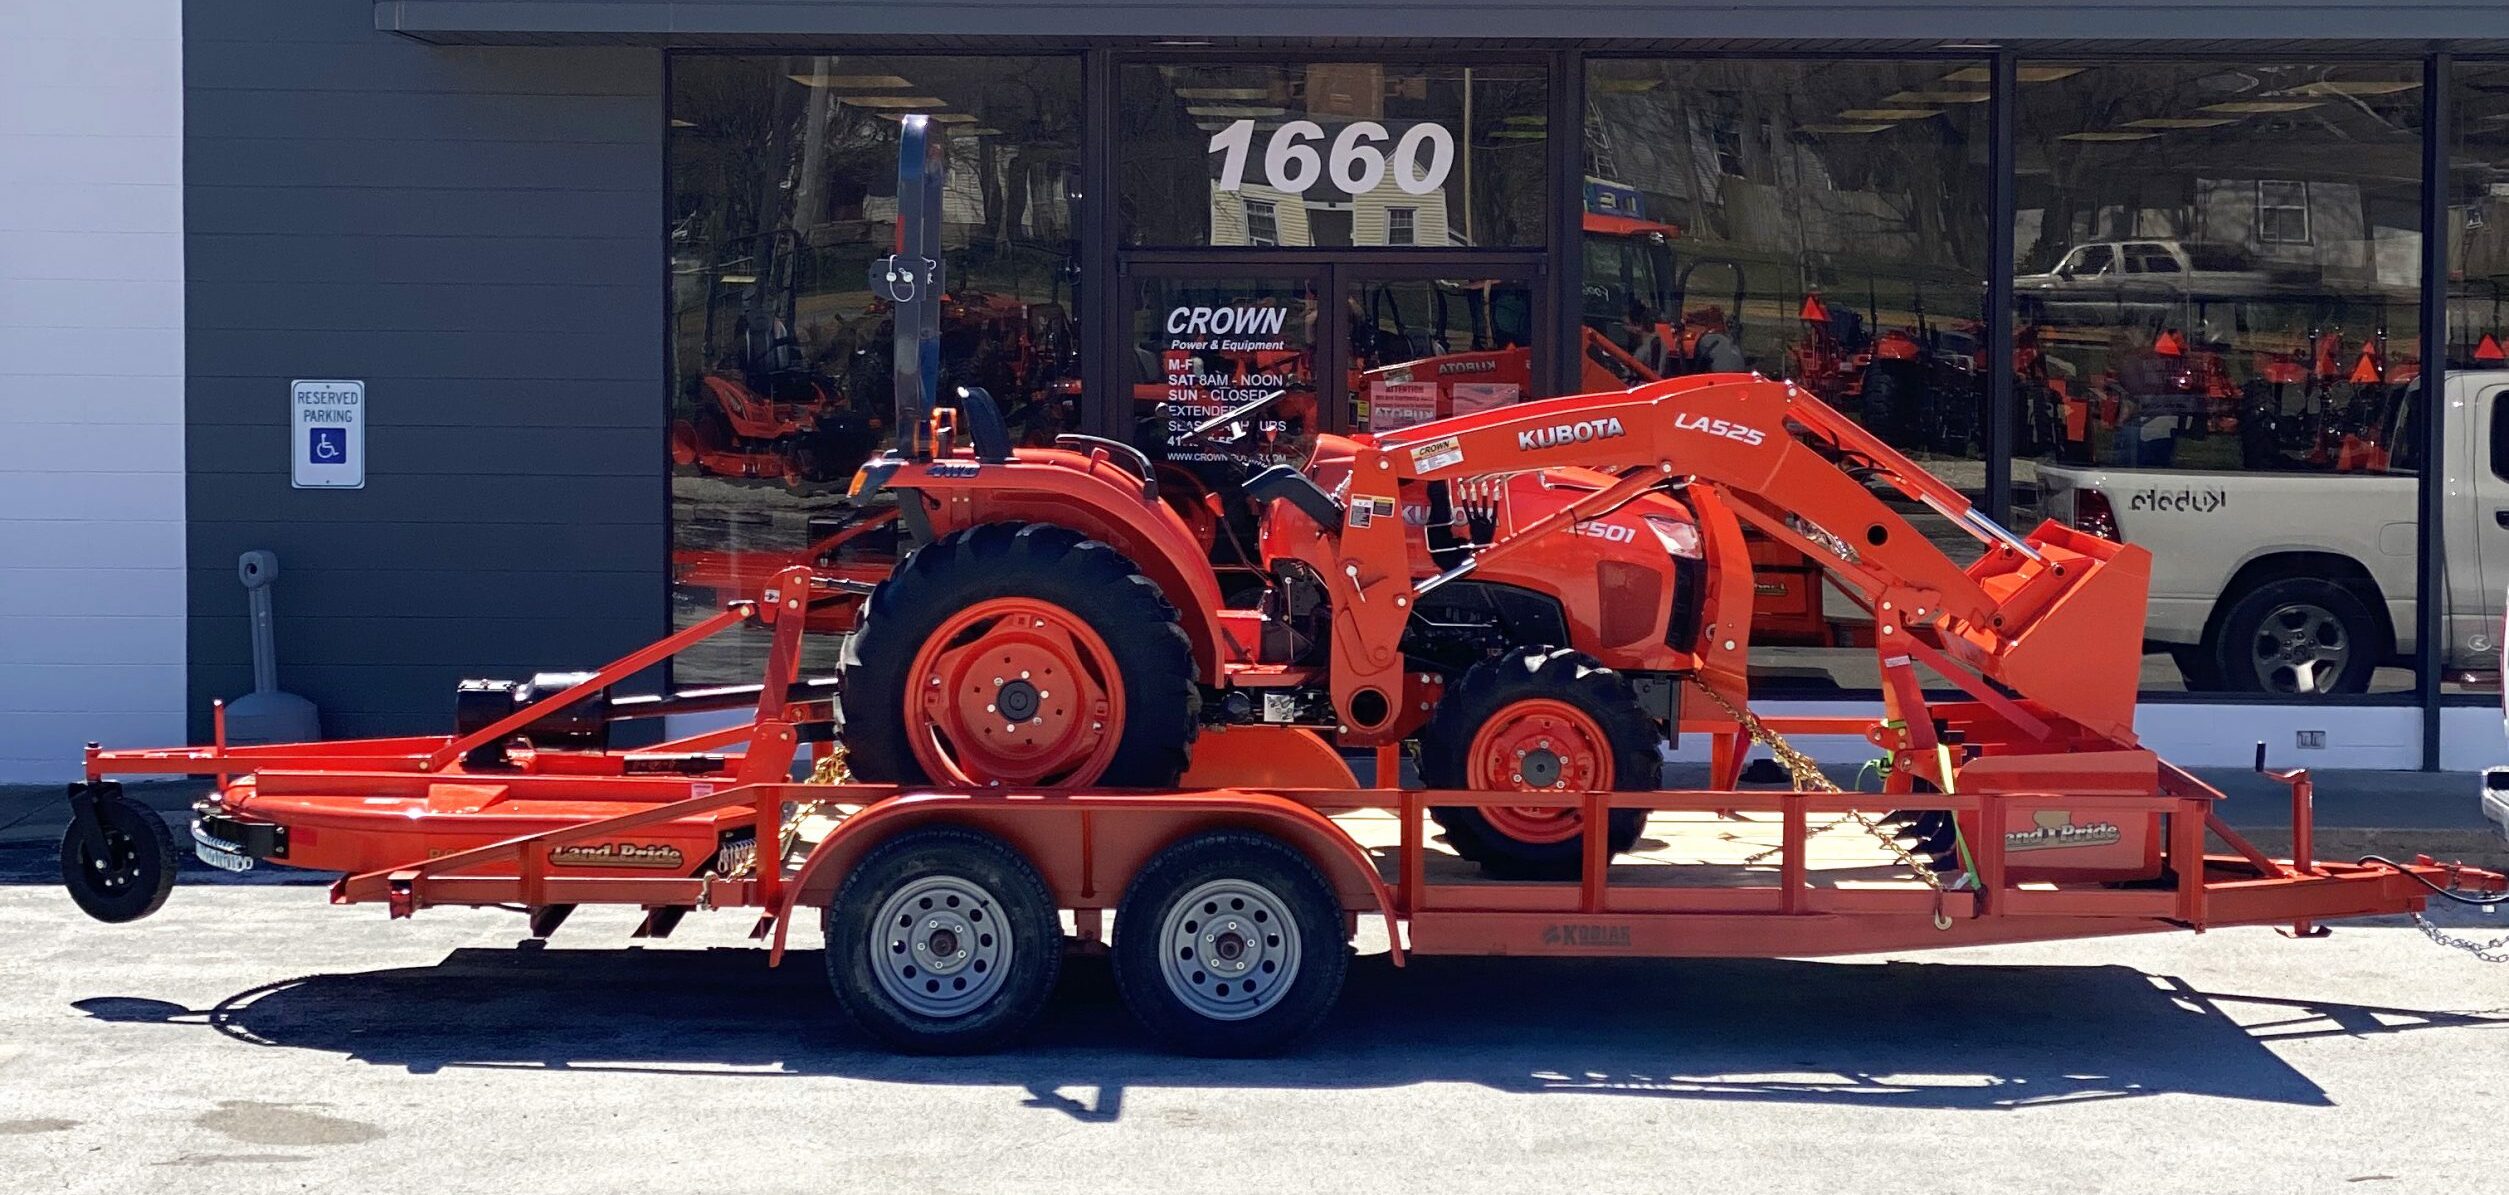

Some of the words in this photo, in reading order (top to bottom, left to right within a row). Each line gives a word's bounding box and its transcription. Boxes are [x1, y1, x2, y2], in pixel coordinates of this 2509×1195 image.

[1207, 119, 1455, 195] 1660
[1167, 306, 1287, 335] CROWN
[1171, 339, 1208, 350] Power
[1209, 340, 1219, 350] &
[1221, 339, 1285, 352] Equipment
[1168, 359, 1193, 371] M-F
[1168, 374, 1195, 386] SAT
[1199, 374, 1229, 386] 8AM
[1240, 374, 1283, 386] NOON
[298, 391, 358, 405] RESERVED
[1168, 389, 1198, 401] SUN
[1210, 389, 1269, 402] CLOSED
[304, 409, 353, 422] PARKING
[1518, 417, 1626, 450] KUBOTA
[1674, 412, 1767, 446] LA525
[1419, 440, 1450, 456] CROWN
[1561, 520, 1636, 543] 2501
[2004, 828, 2044, 844] and
[2060, 823, 2119, 842] Pride
[553, 844, 613, 860] Land
[619, 844, 682, 861] Pride
